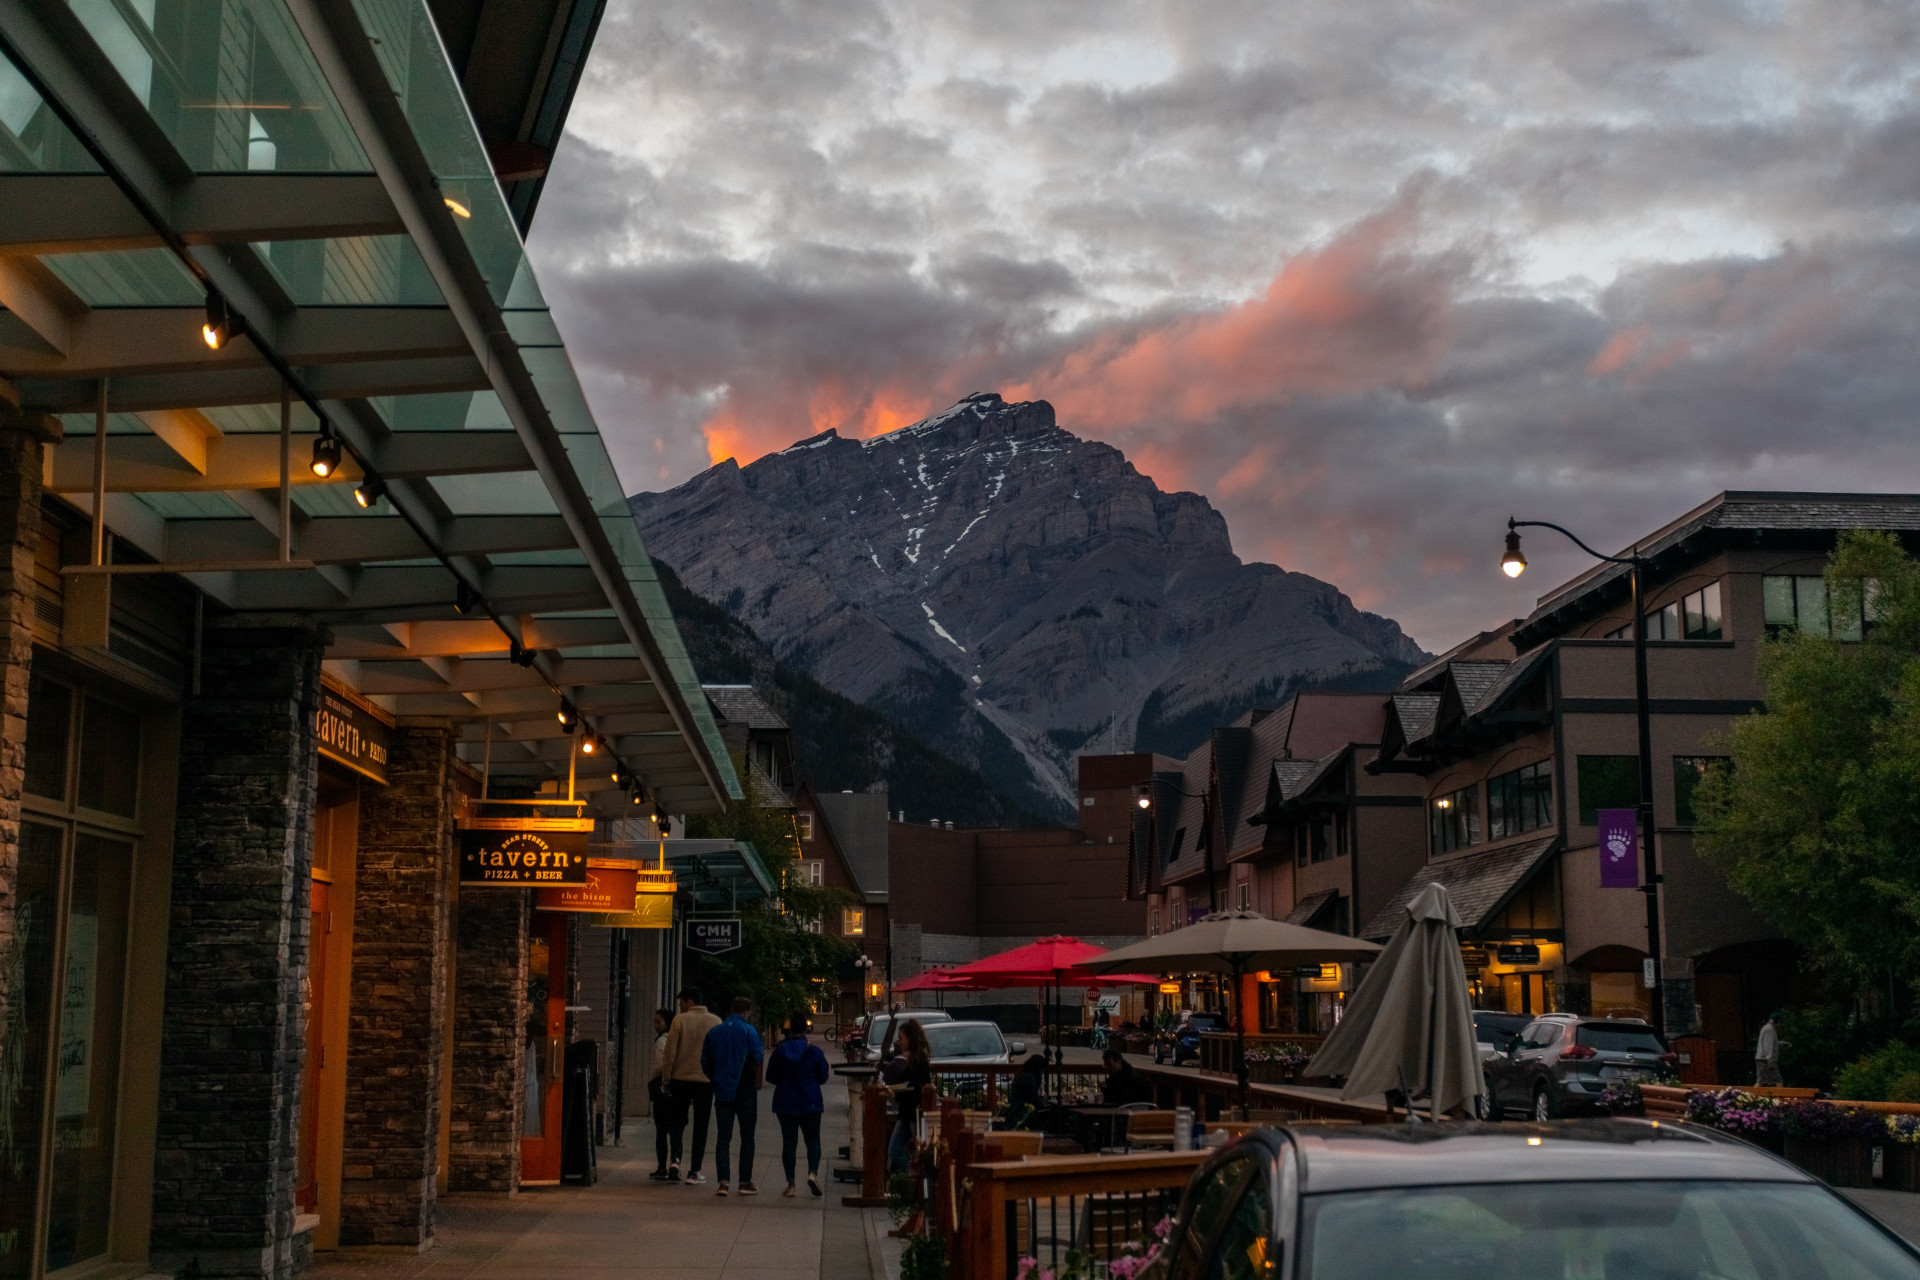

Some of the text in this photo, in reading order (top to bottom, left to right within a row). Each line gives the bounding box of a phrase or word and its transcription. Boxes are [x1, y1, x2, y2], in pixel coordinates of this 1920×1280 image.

[370, 741, 387, 765] PATIO
[501, 833, 549, 851] BEAR STREET
[479, 847, 569, 868] tavern
[484, 870, 519, 879] PIZZA
[535, 871, 563, 880] BEER
[561, 891, 611, 901] the bison
[696, 924, 731, 936] CMH
[1087, 990, 1100, 998] STOP
